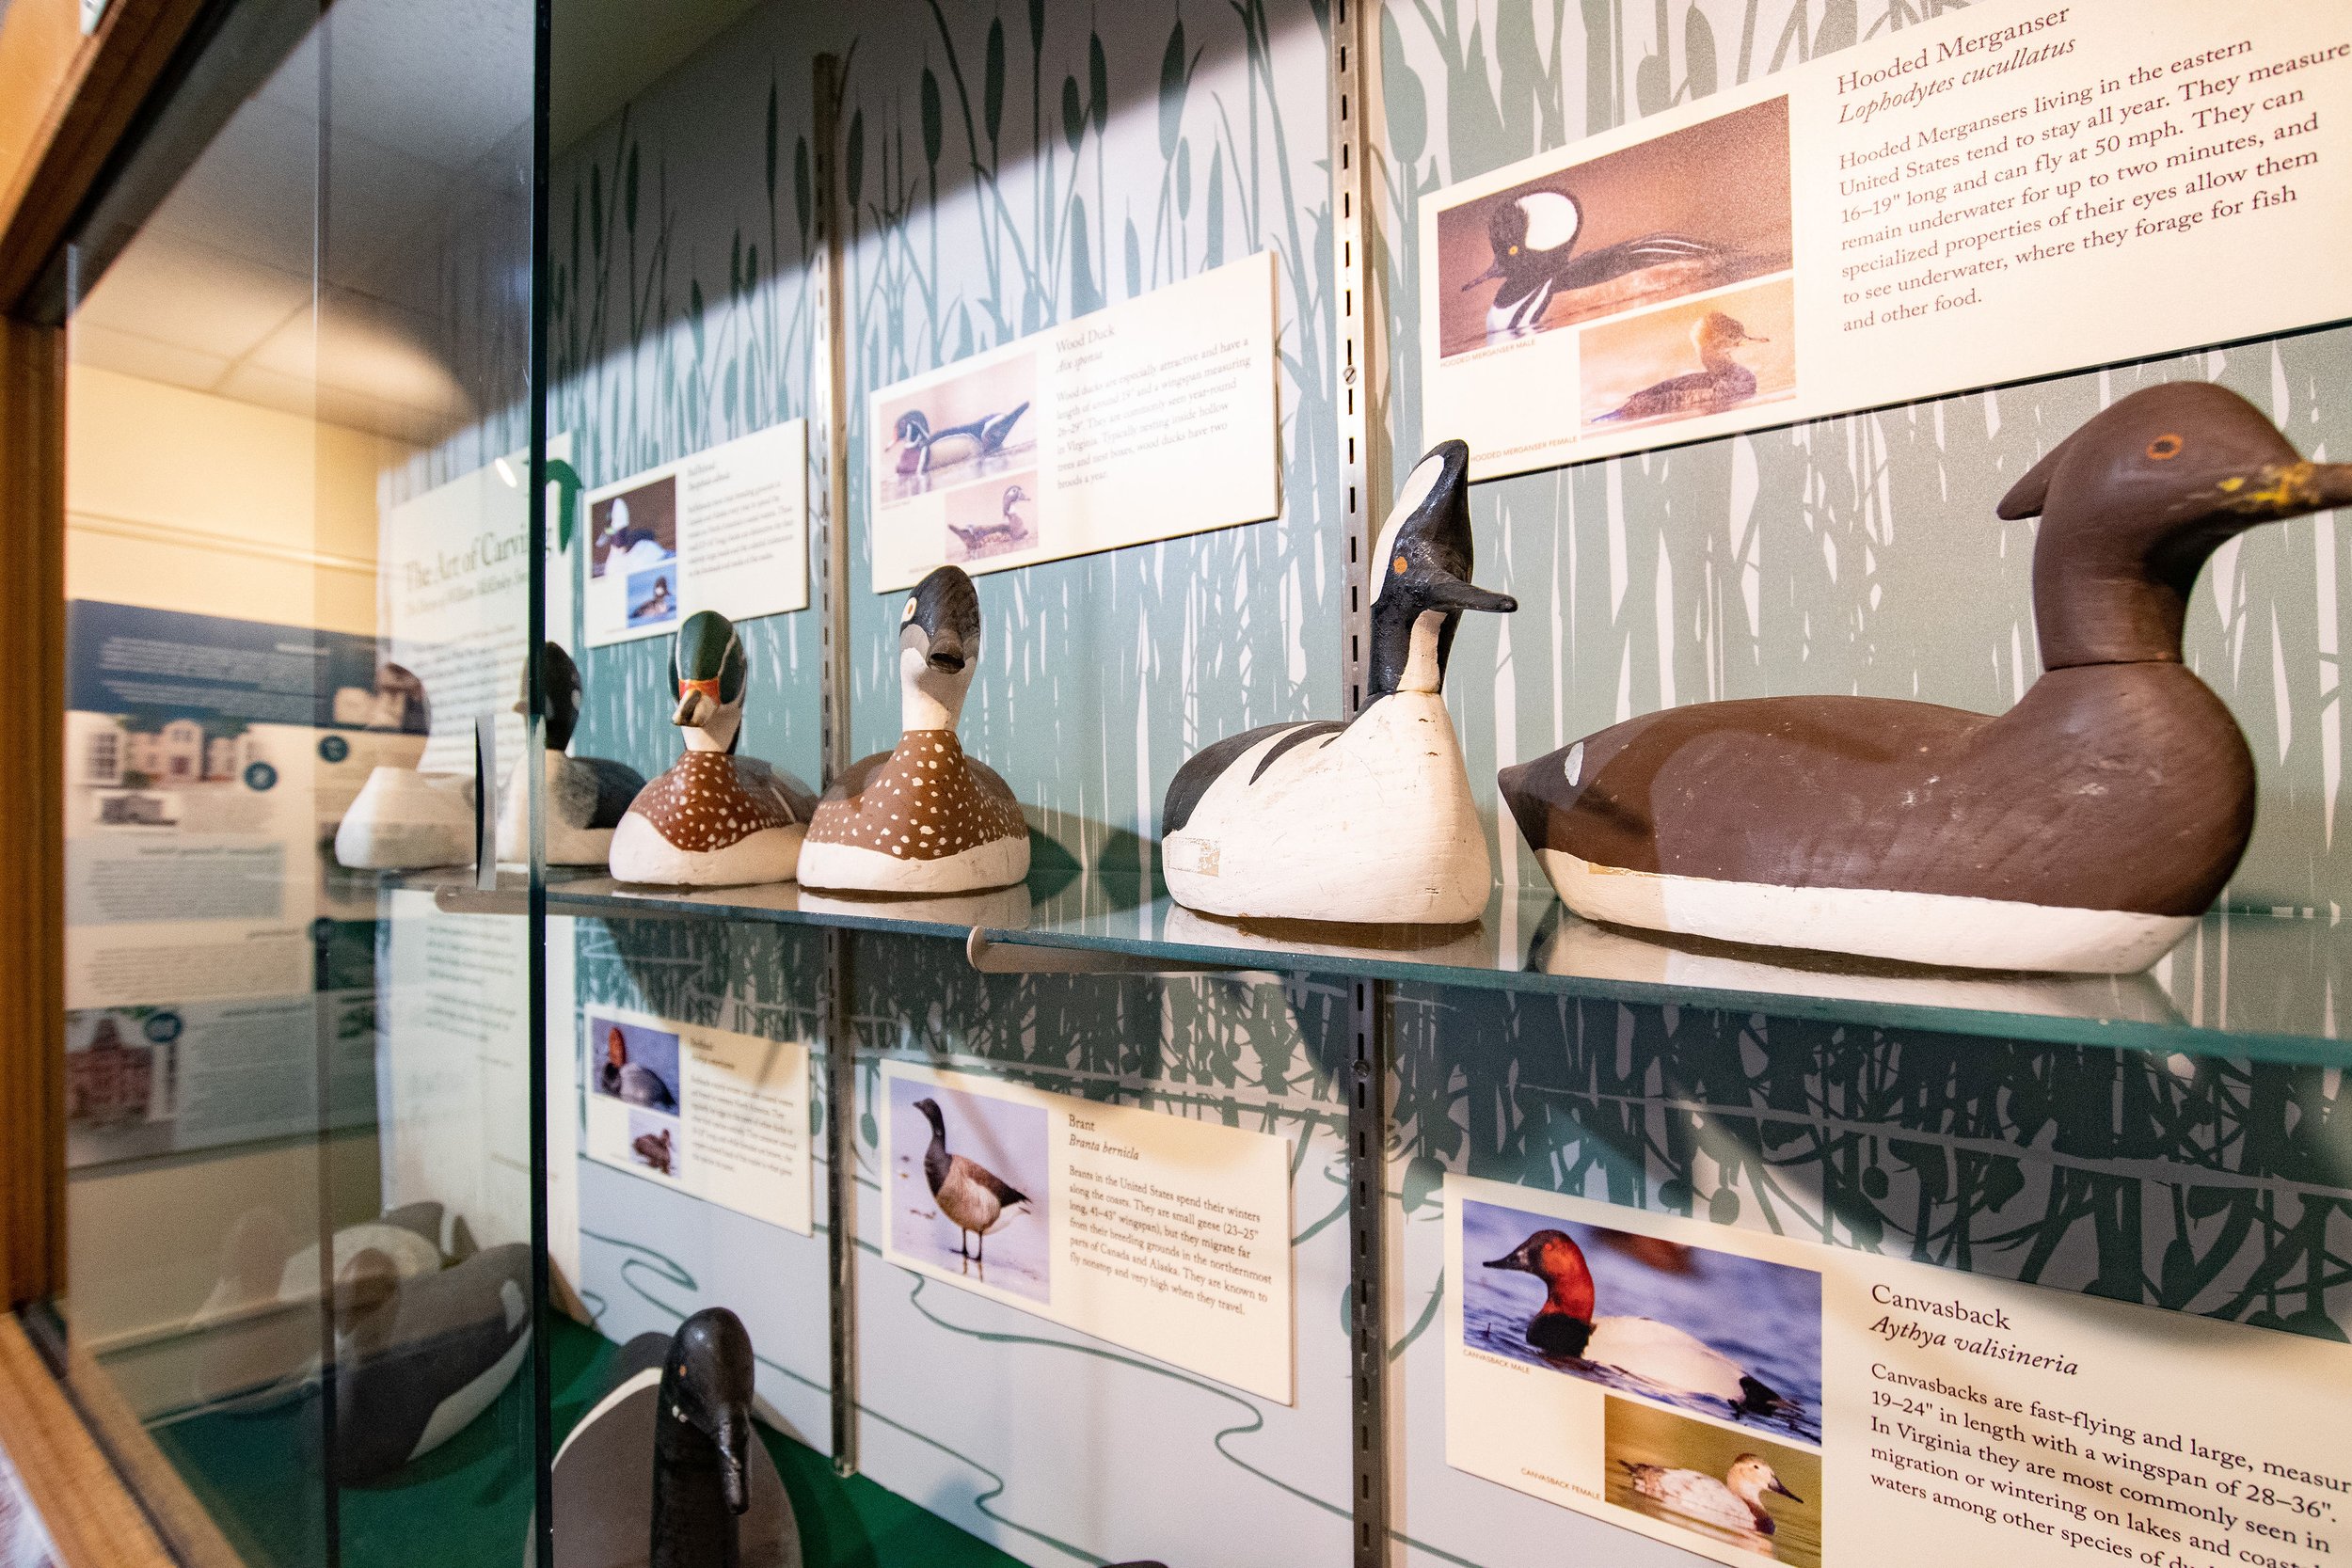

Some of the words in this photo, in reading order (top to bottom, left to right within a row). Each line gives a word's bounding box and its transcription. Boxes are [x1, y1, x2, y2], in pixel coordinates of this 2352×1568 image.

[1837, 47, 1929, 95] Hooded
[1936, 8, 2070, 63] Merganser
[1838, 76, 1955, 123] Lophodytes
[1961, 39, 2075, 86] cucullatus
[1839, 135, 1911, 169] Hooded
[1918, 106, 2027, 147] Mergansers
[2034, 87, 2092, 113] living
[2100, 78, 2121, 94] in
[2128, 66, 2162, 86] the
[2169, 40, 2252, 73] eastern
[1839, 166, 1899, 196] United
[1906, 154, 1960, 178] States
[1966, 135, 2008, 161] tend
[2015, 134, 2034, 148] to
[2042, 120, 2081, 141] stay
[2087, 105, 2113, 128] all
[2120, 96, 2169, 125] year.
[2177, 75, 2239, 101] They
[2249, 43, 2350, 83] measure
[1841, 225, 1901, 251] remain
[1908, 197, 2015, 233] underwater
[2021, 186, 2050, 205] for
[2056, 180, 2081, 198] up
[2089, 173, 2109, 187] to
[2117, 160, 2158, 181] two
[2166, 134, 2264, 168] minutes,
[2273, 111, 2318, 140] and
[1906, 186, 1947, 206] long
[1952, 169, 1987, 194] and
[1994, 165, 2027, 182] can
[2035, 152, 2062, 173] fly
[2069, 147, 2088, 163] at
[2094, 135, 2121, 156] 50
[2128, 119, 2183, 148] mph.
[2191, 103, 2254, 128] They
[2262, 89, 2303, 110] can
[1841, 239, 1938, 281] specialized
[1946, 219, 2042, 258] properties
[2048, 205, 2072, 227] of
[2075, 197, 2125, 220] their
[2132, 186, 2177, 211] eyes
[2185, 168, 2247, 194] allow
[2256, 150, 2318, 177] them
[1842, 292, 1860, 304] to
[1865, 284, 1891, 299] see
[1897, 258, 2008, 292] underwater,
[2015, 241, 2074, 263] where
[2082, 228, 2128, 248] they
[2135, 211, 2202, 237] forage
[2211, 199, 2244, 219] for
[2252, 184, 2296, 210] fish
[1843, 309, 1874, 332] and
[1881, 303, 1928, 323] other
[1934, 287, 1981, 311] food.
[1440, 356, 1470, 368] HOODED
[1472, 344, 1515, 359] MERGANSER
[1516, 339, 1535, 348] MALE
[1470, 451, 1502, 463] HOODED
[1503, 440, 1548, 456] MERGANSER
[1549, 436, 1578, 448] FEMALE
[1068, 1113, 1095, 1132] Brant
[1068, 1132, 1100, 1151] Branta
[1102, 1141, 1139, 1161] bernicla
[1069, 1182, 1089, 1198] along
[1091, 1188, 1104, 1200] the
[1132, 1197, 1156, 1218] They
[1157, 1208, 1170, 1218] are
[1171, 1212, 1195, 1226] small
[1197, 1218, 1220, 1231] geese
[1069, 1199, 1089, 1216] long,
[1118, 1214, 1164, 1237] wingspan),
[1164, 1225, 1178, 1239] but
[1180, 1230, 1200, 1247] they
[1200, 1238, 1235, 1255] migrate
[1237, 1244, 1251, 1259] far
[1104, 1175, 1118, 1187] the
[1120, 1177, 1148, 1195] United
[1150, 1184, 1174, 1200] States
[1176, 1195, 1200, 1208] spend
[1202, 1198, 1225, 1213] their
[1227, 1207, 1261, 1223] winters
[1069, 1216, 1088, 1231] from
[1089, 1222, 1108, 1237] their
[1109, 1227, 1145, 1250] breeding
[1146, 1241, 1180, 1258] grounds
[1193, 1252, 1207, 1265] the
[1209, 1259, 1272, 1284] northernmost
[1868, 1315, 1947, 1349] Aythya
[1953, 1338, 2078, 1375] valisineria
[1871, 1284, 2011, 1331] Canvasback
[1463, 1349, 1508, 1367] CANVASBACK
[1511, 1363, 1531, 1374] MALE
[1870, 1363, 1987, 1404] Canvasbacks
[1994, 1397, 2023, 1413] are
[2029, 1400, 2136, 1446] fast-flying
[2142, 1433, 2183, 1452] and
[2189, 1437, 2253, 1472] large,
[2263, 1462, 2352, 1494] measur
[1939, 1406, 1957, 1425] in
[1963, 1412, 2026, 1443] length
[2030, 1433, 2078, 1456] with
[2085, 1448, 2096, 1461] a
[2101, 1451, 2207, 1489] wingspan
[2215, 1479, 2242, 1497] of
[1520, 1467, 1570, 1490] CANVASBACK
[1572, 1484, 1600, 1500] FEMALE
[1870, 1415, 1890, 1435] In
[1896, 1421, 1972, 1457] Virginia
[1978, 1445, 2020, 1473] they
[2026, 1462, 2056, 1479] are
[2062, 1471, 2114, 1495] most
[2119, 1486, 2238, 1531] commonly
[2245, 1520, 2297, 1544] seen
[2306, 1530, 2330, 1553] in
[1870, 1448, 1959, 1481] migration
[1964, 1474, 1985, 1488] or
[1990, 1480, 2087, 1521] wintering
[2092, 1509, 2120, 1526] on
[2126, 1512, 2181, 1543] lakes
[2188, 1535, 2231, 1557] and
[1870, 1474, 1927, 1499] waters
[1932, 1492, 1997, 1524] among
[2002, 1512, 2055, 1536] other
[2060, 1528, 2132, 1559] species
[2139, 1550, 2163, 1568] of
